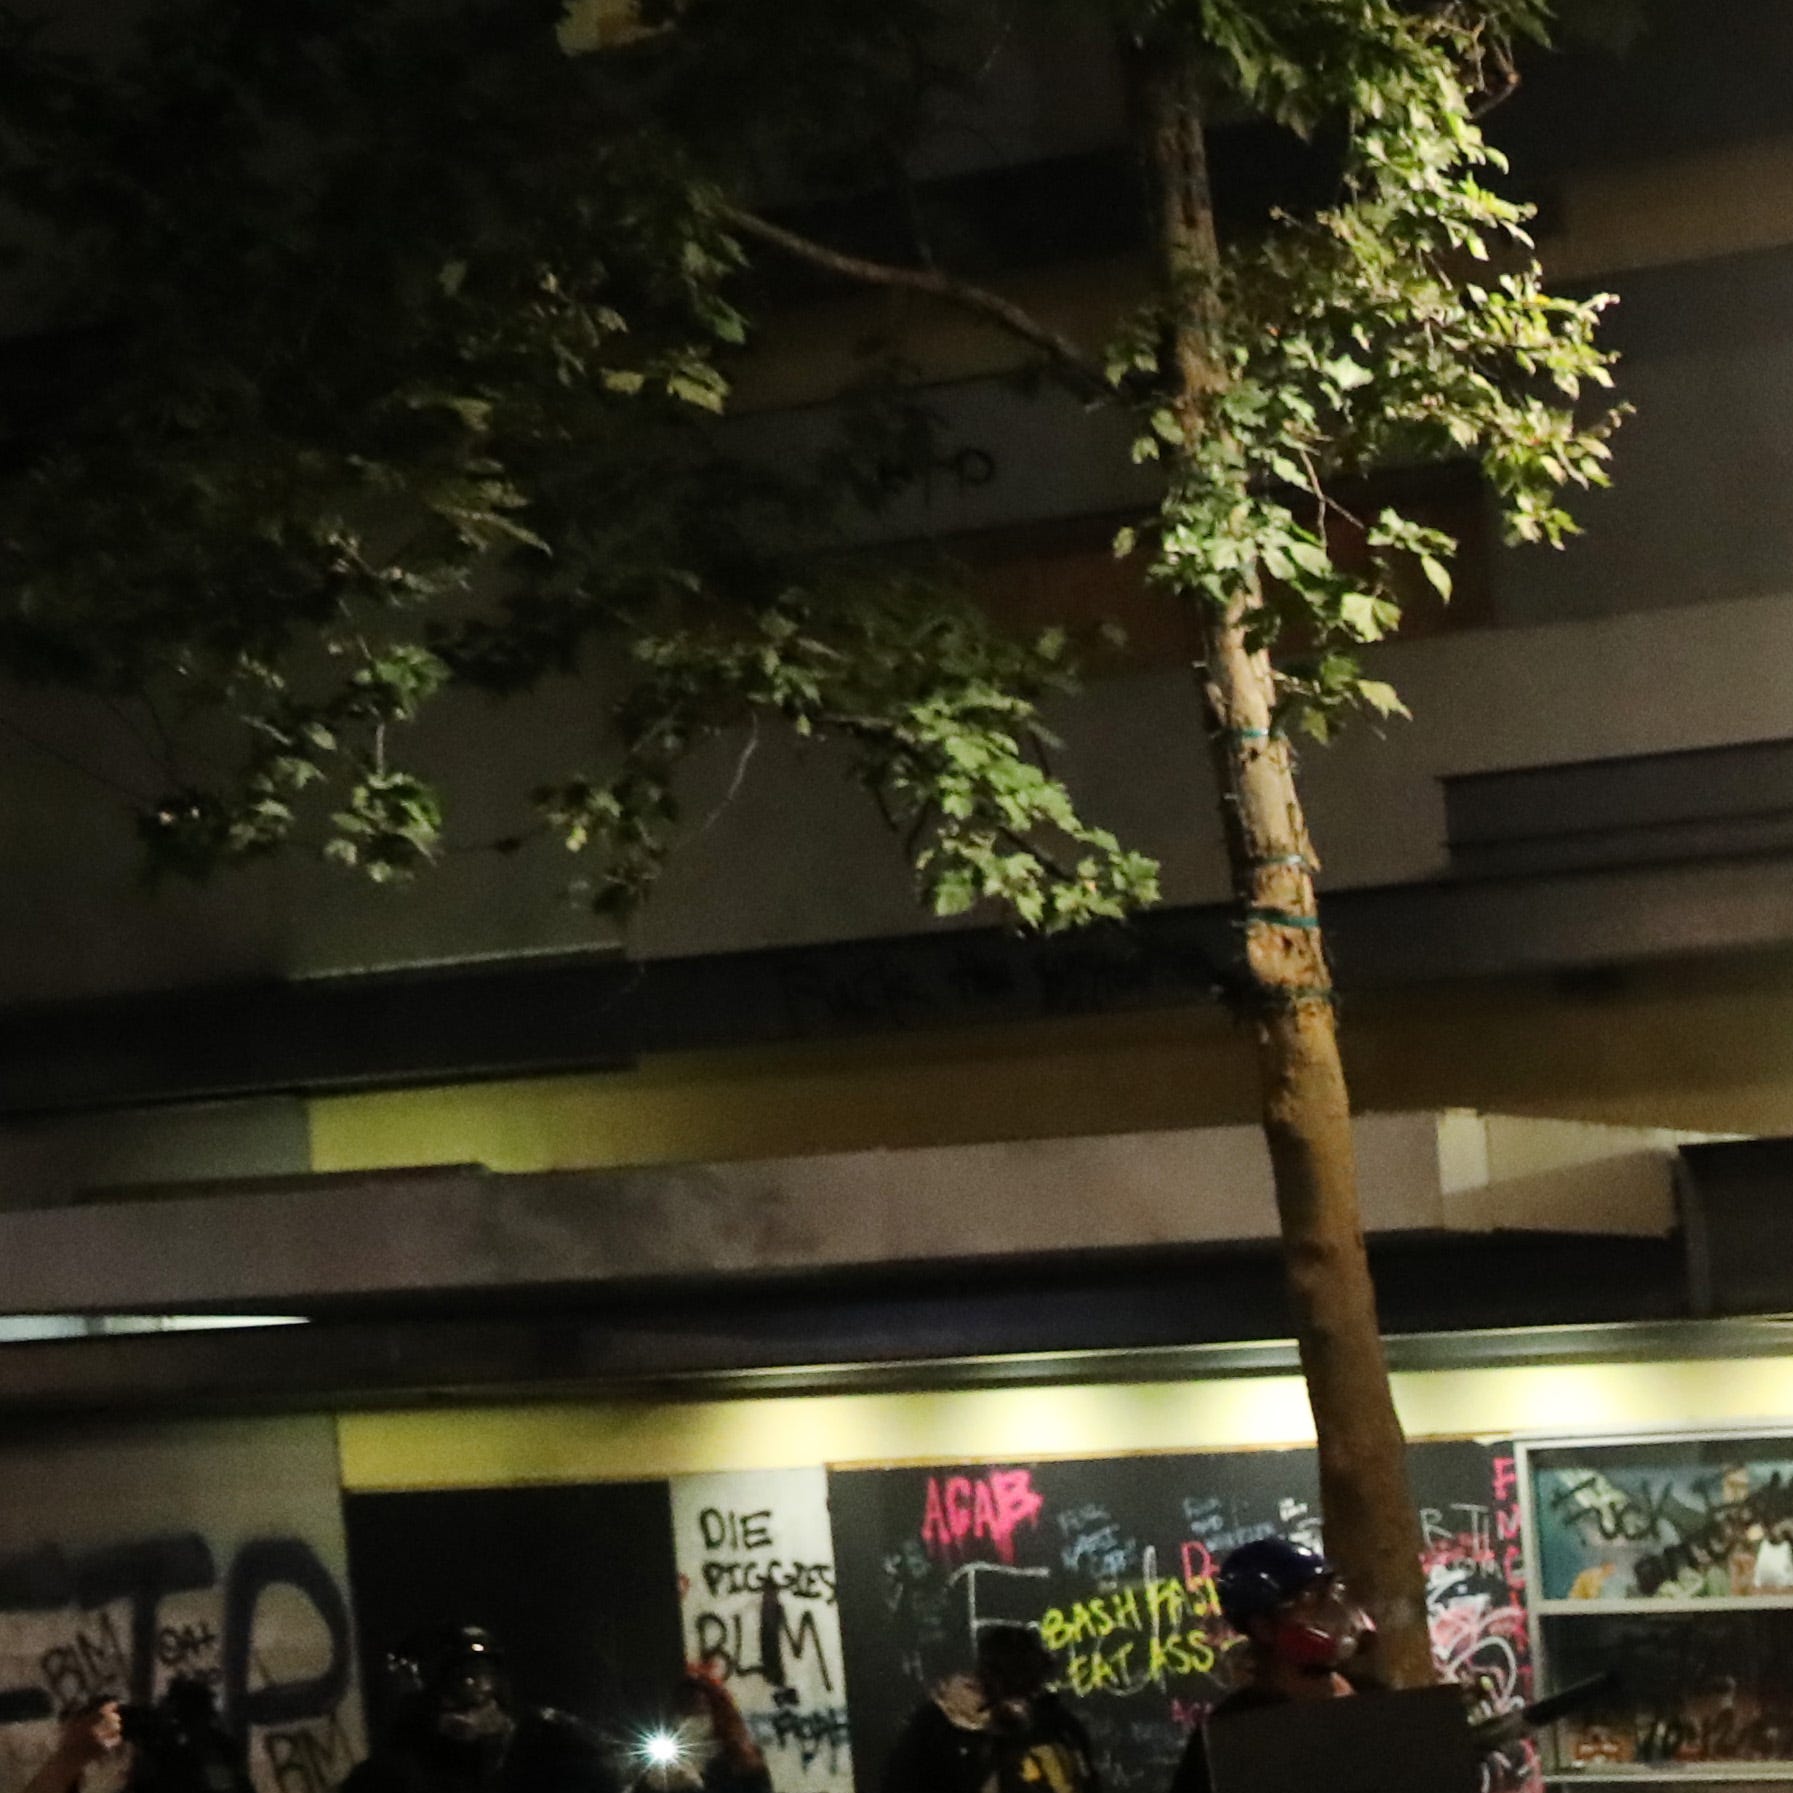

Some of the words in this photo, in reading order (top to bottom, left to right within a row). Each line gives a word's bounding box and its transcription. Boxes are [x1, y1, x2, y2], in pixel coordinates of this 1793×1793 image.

[699, 1507, 772, 1550] DIE
[920, 1469, 1044, 1562] ACAB
[695, 1609, 833, 1691] BLM
[1041, 1585, 1143, 1650] BASH
[1066, 1641, 1135, 1698] EAT
[1149, 1628, 1216, 1683] ASS
